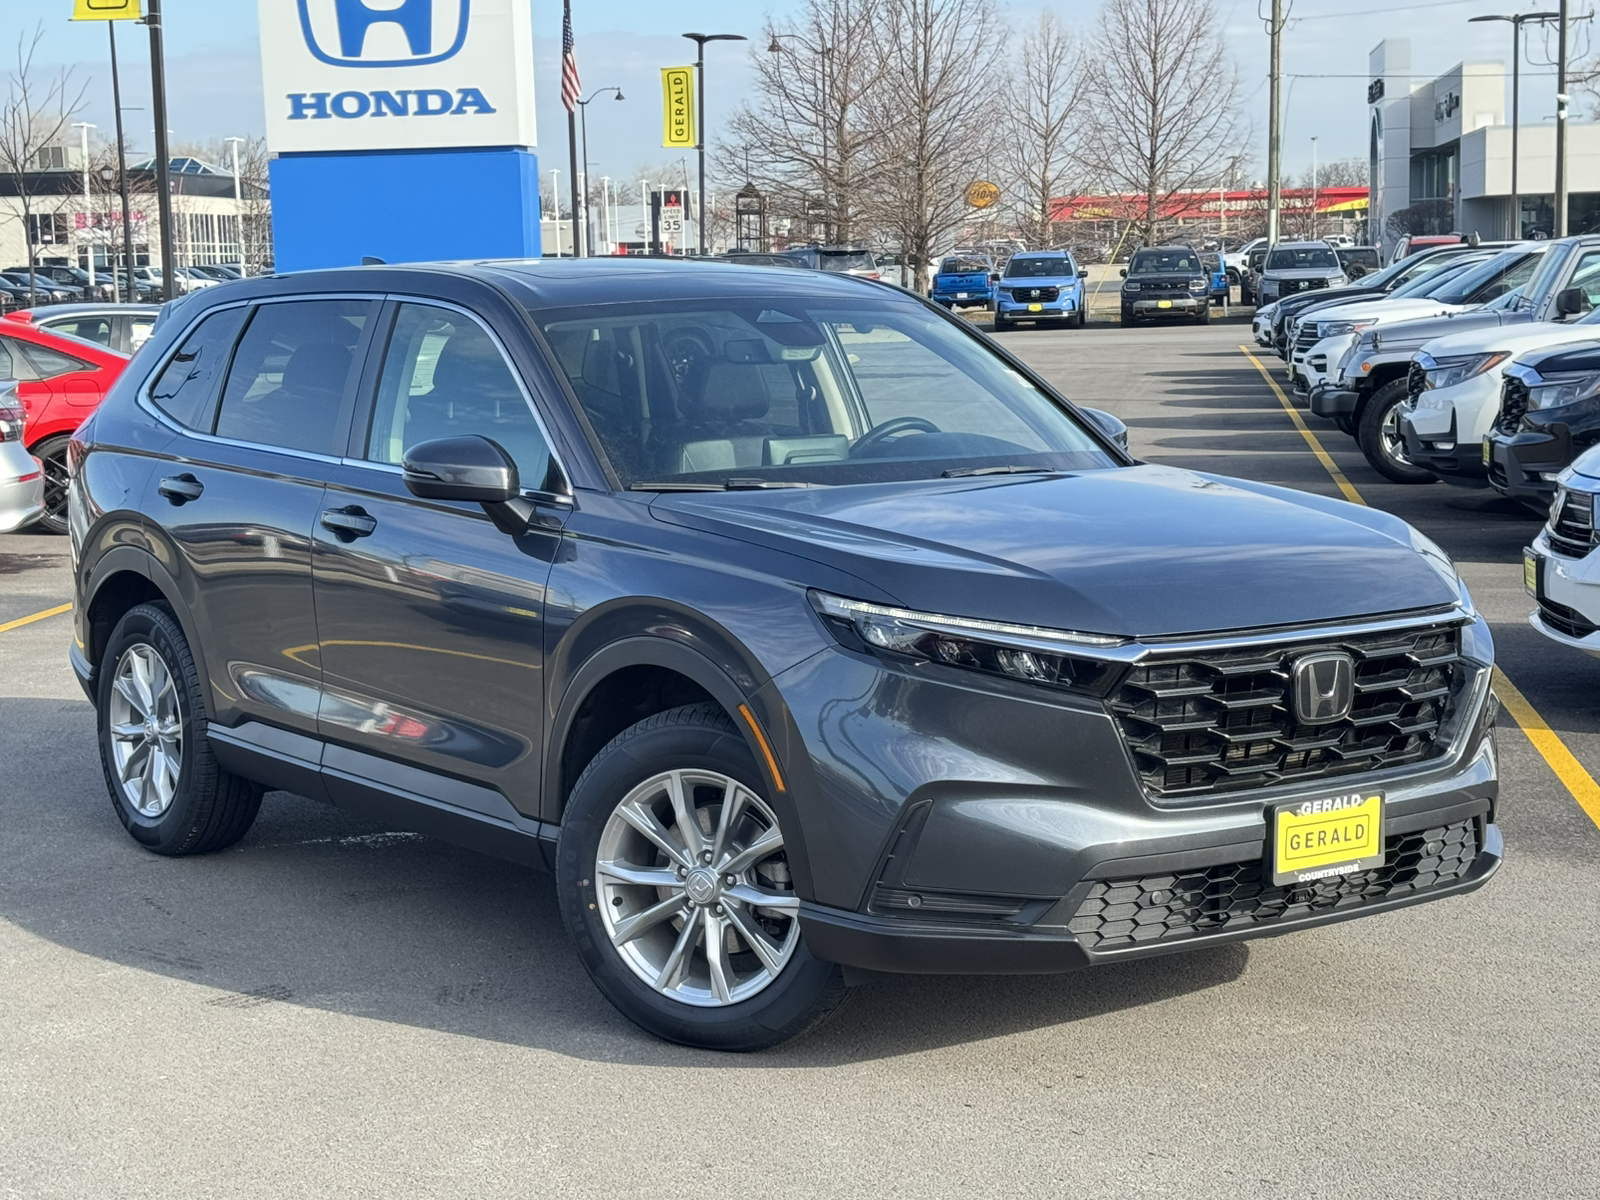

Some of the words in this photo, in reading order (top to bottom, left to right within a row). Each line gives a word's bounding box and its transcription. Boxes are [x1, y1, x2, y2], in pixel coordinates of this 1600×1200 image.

[285, 88, 497, 120] HONDA
[673, 77, 685, 137] GERALD
[663, 220, 681, 231] 35
[1300, 794, 1361, 816] GERALD
[1290, 823, 1365, 851] GERALD
[1298, 863, 1361, 882] COUNTRYSIDE
